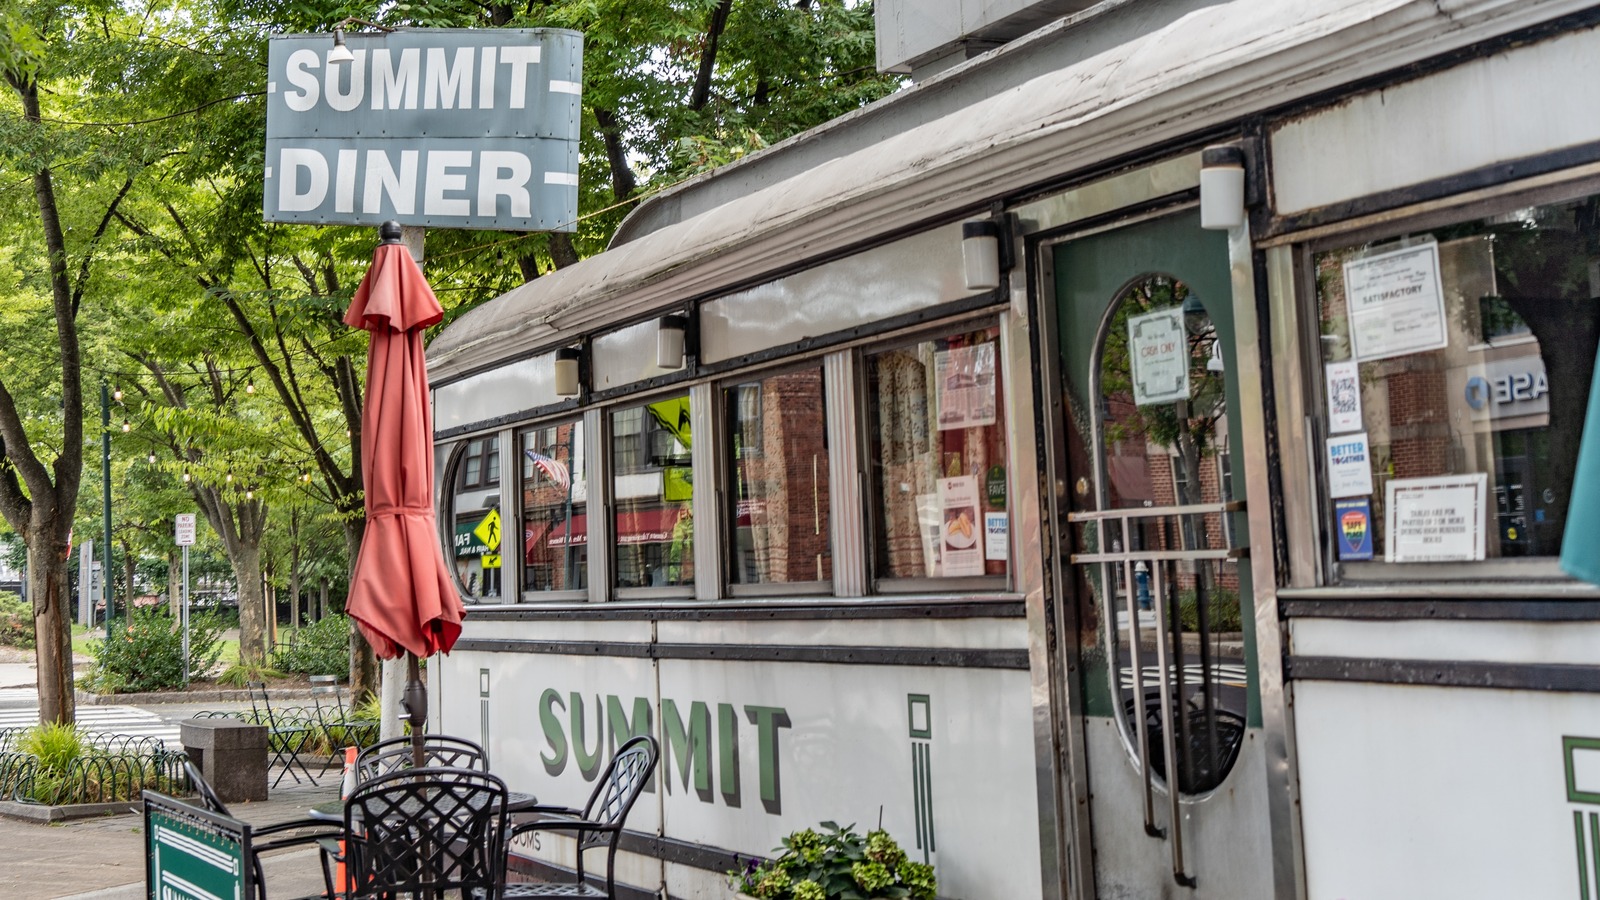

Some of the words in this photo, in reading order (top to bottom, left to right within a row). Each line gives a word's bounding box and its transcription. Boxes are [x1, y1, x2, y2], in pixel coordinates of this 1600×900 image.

[284, 46, 541, 112] SUMMIT
[279, 148, 532, 218] DINER
[1362, 284, 1423, 304] SATISFACTORY
[1331, 442, 1363, 457] BETTER
[1332, 454, 1365, 465] TOGETHER
[989, 484, 1006, 496] FAVE
[1346, 521, 1362, 530] SAFE
[1346, 531, 1364, 540] PLACE
[539, 688, 792, 816] SUMMIT
